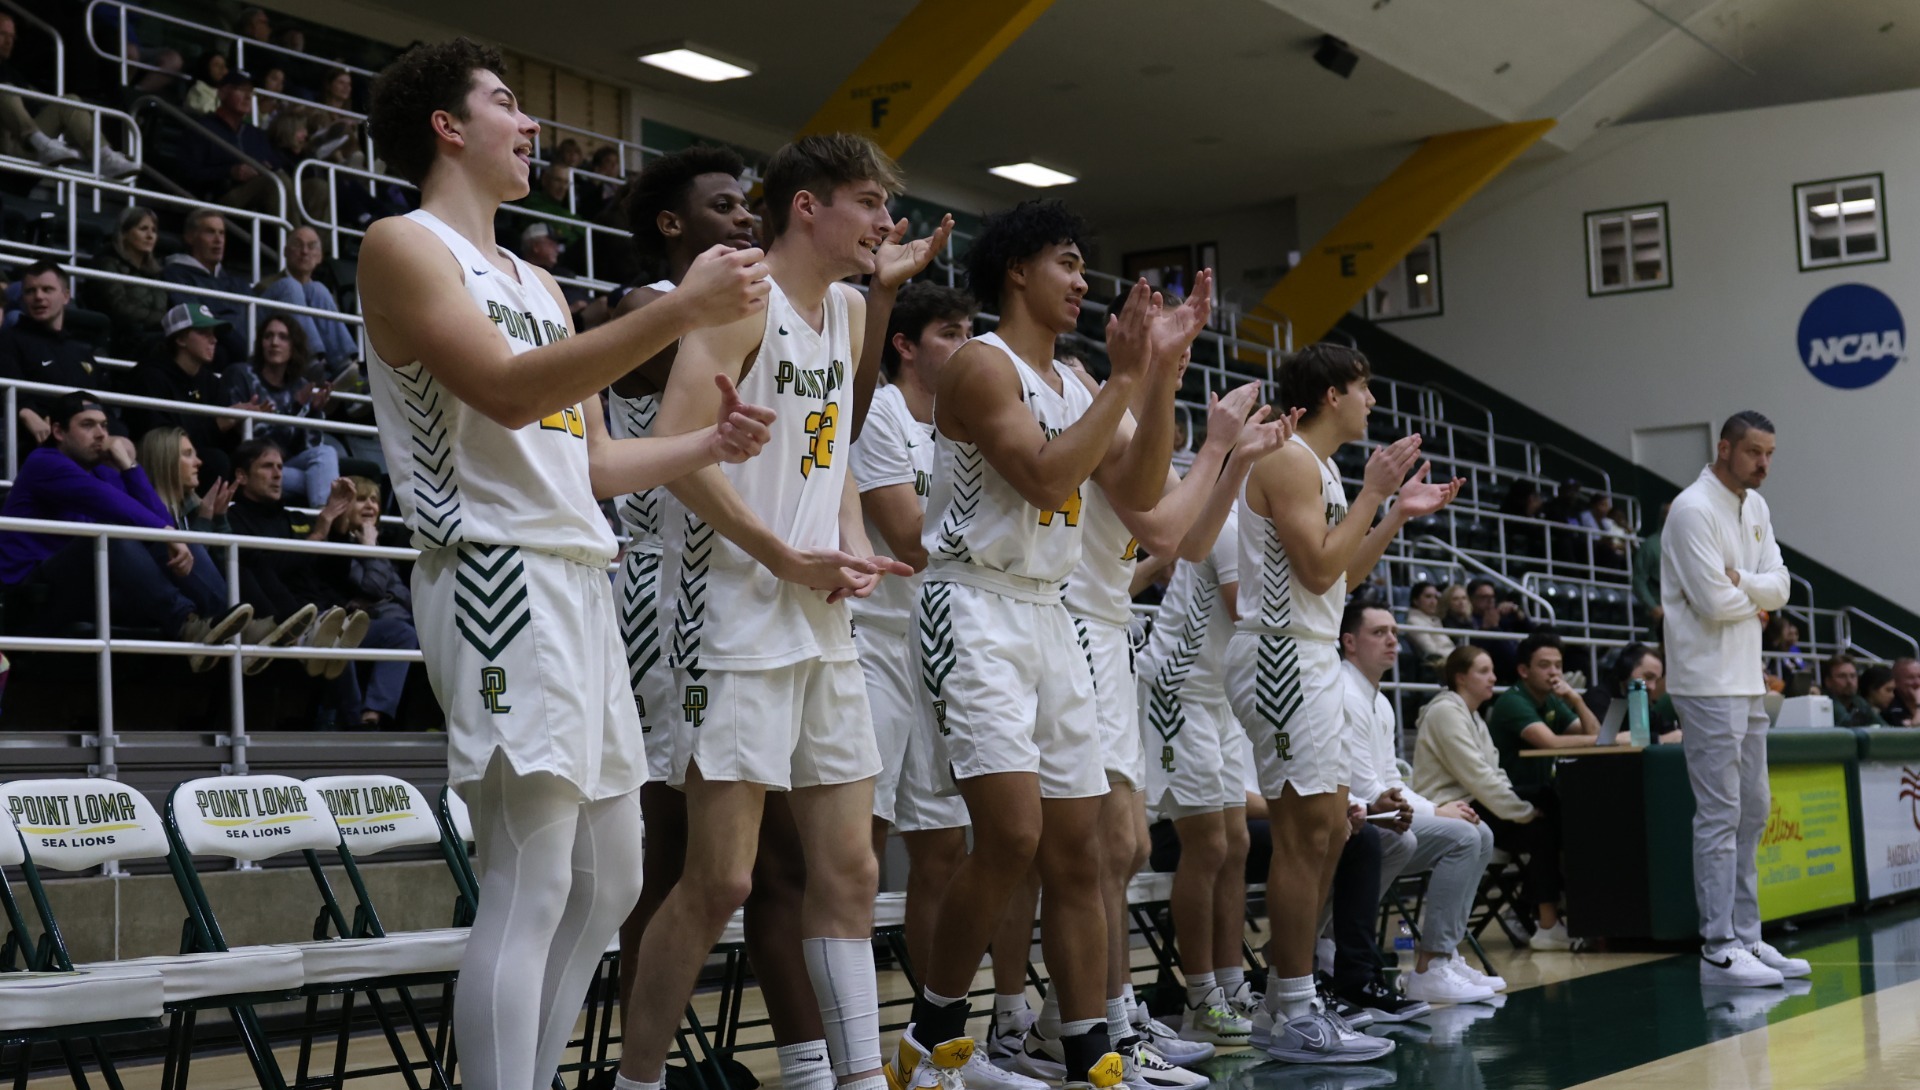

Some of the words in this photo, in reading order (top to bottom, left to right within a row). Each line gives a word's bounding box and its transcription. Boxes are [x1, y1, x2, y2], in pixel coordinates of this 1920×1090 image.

[871, 96, 890, 129] F
[1341, 253, 1357, 278] E
[1808, 329, 1907, 368] NCAA
[800, 401, 839, 481] 32
[8, 795, 70, 826] POINT
[73, 792, 136, 825] LOMA
[195, 789, 250, 818] POINT
[252, 785, 308, 817] LOMA
[362, 784, 411, 814] LOMA
[41, 838, 67, 848] SEA
[72, 835, 116, 848] LIONS
[226, 830, 249, 838] SEA
[253, 826, 291, 838] LIONS
[340, 827, 359, 835] SEA
[363, 824, 396, 835] LIONS
